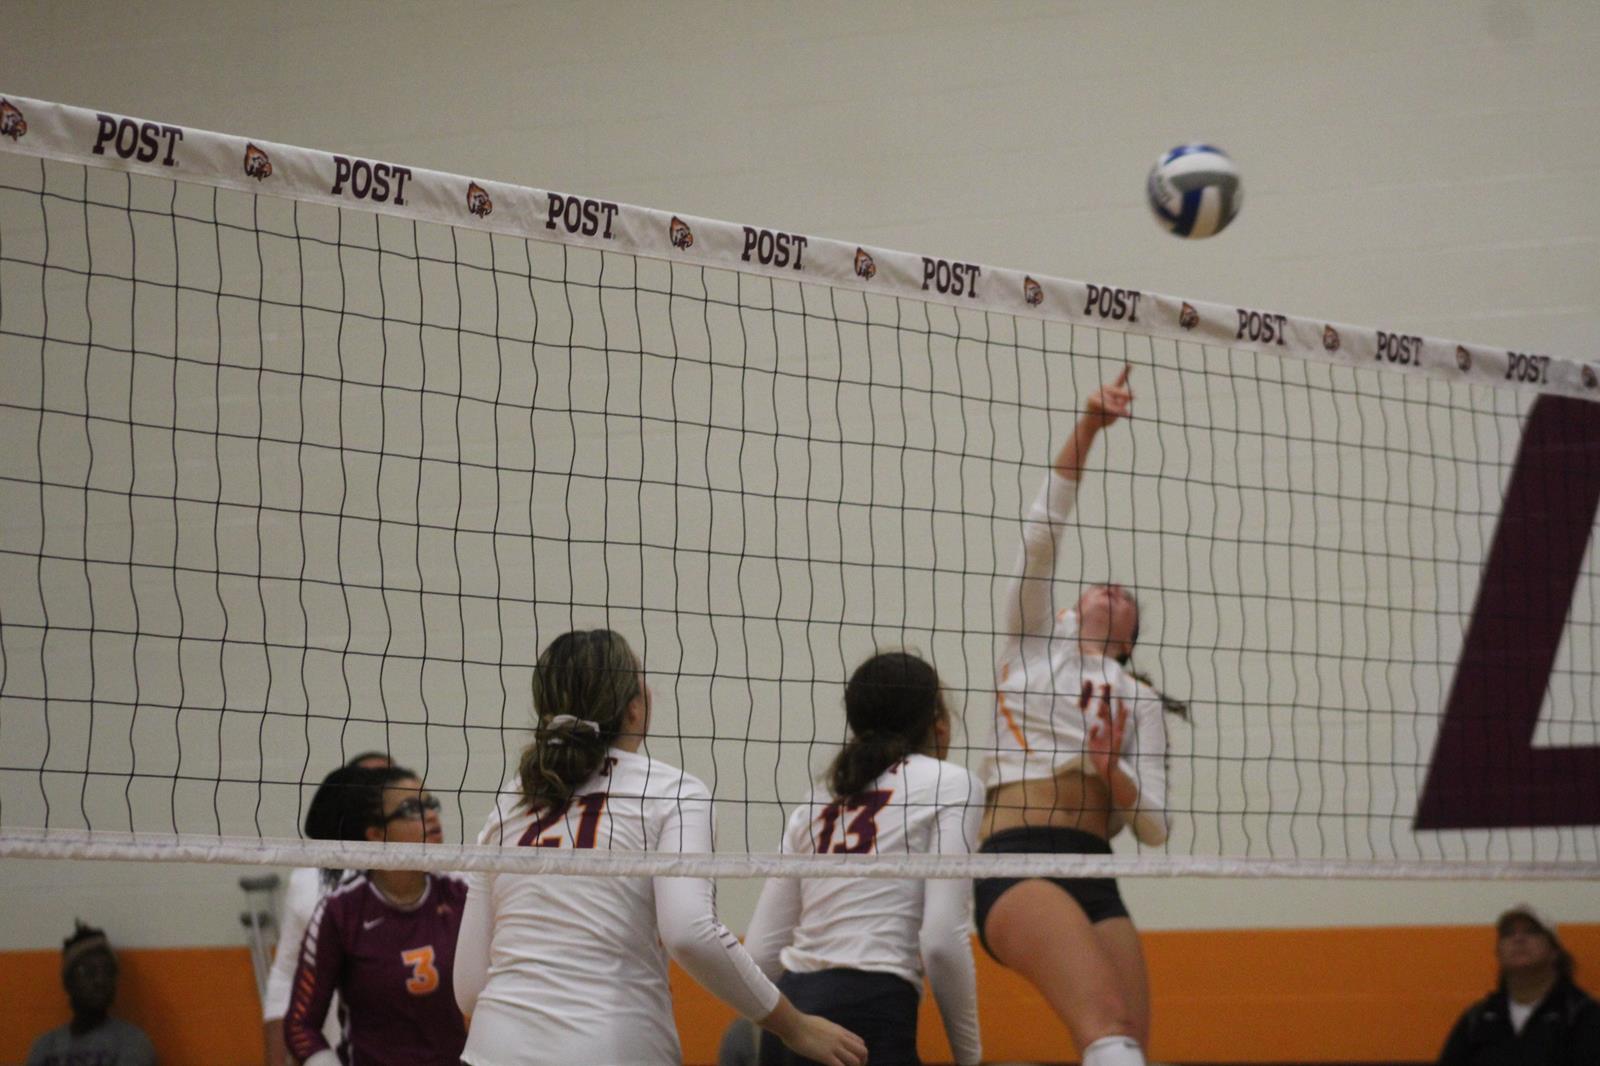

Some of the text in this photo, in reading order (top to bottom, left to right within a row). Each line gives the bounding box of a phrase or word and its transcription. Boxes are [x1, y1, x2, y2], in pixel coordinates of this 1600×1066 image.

[92, 113, 1550, 385] POST POST POST POST POST POST POST POST POST
[817, 789, 894, 854] 13
[401, 945, 440, 994] 3
